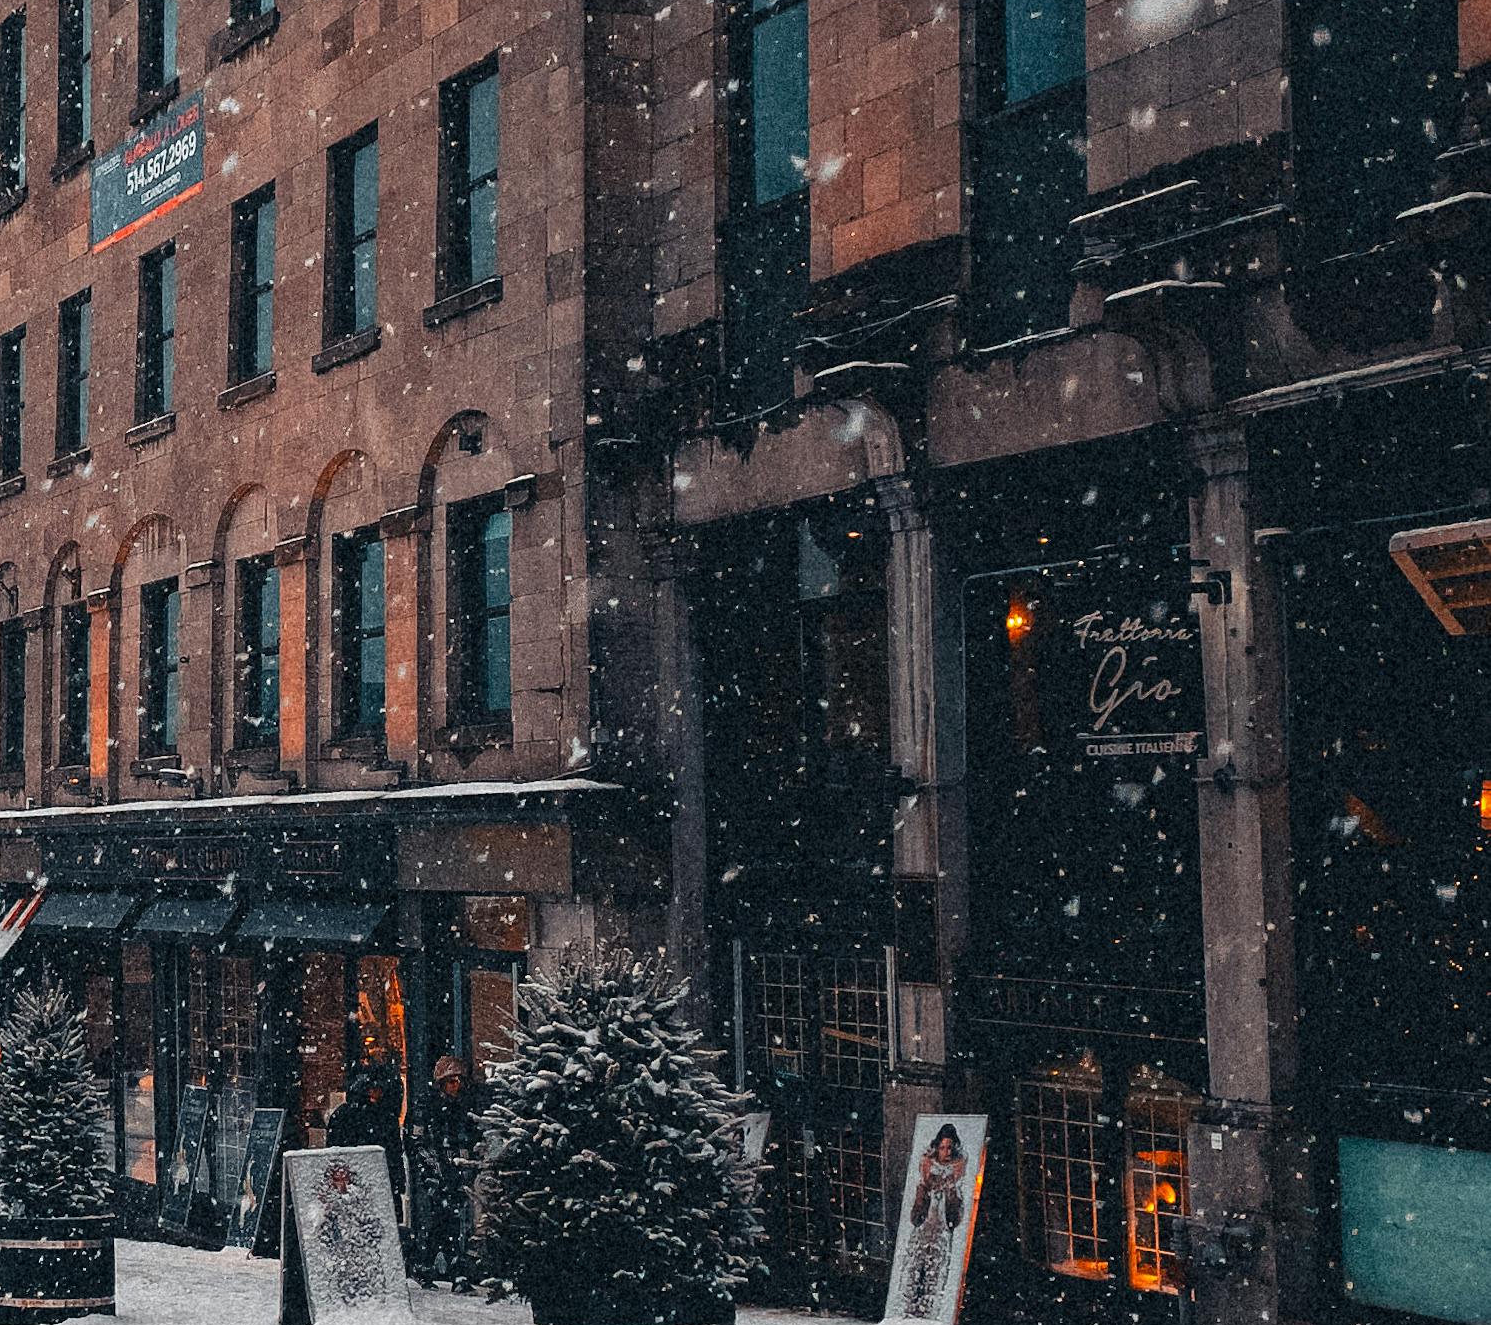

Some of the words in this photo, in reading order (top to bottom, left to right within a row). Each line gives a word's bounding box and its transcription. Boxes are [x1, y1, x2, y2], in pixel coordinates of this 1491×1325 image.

[126, 130, 197, 195] 514.567.2969
[1073, 609, 1194, 649] Trattoria
[1089, 645, 1182, 731] Gio
